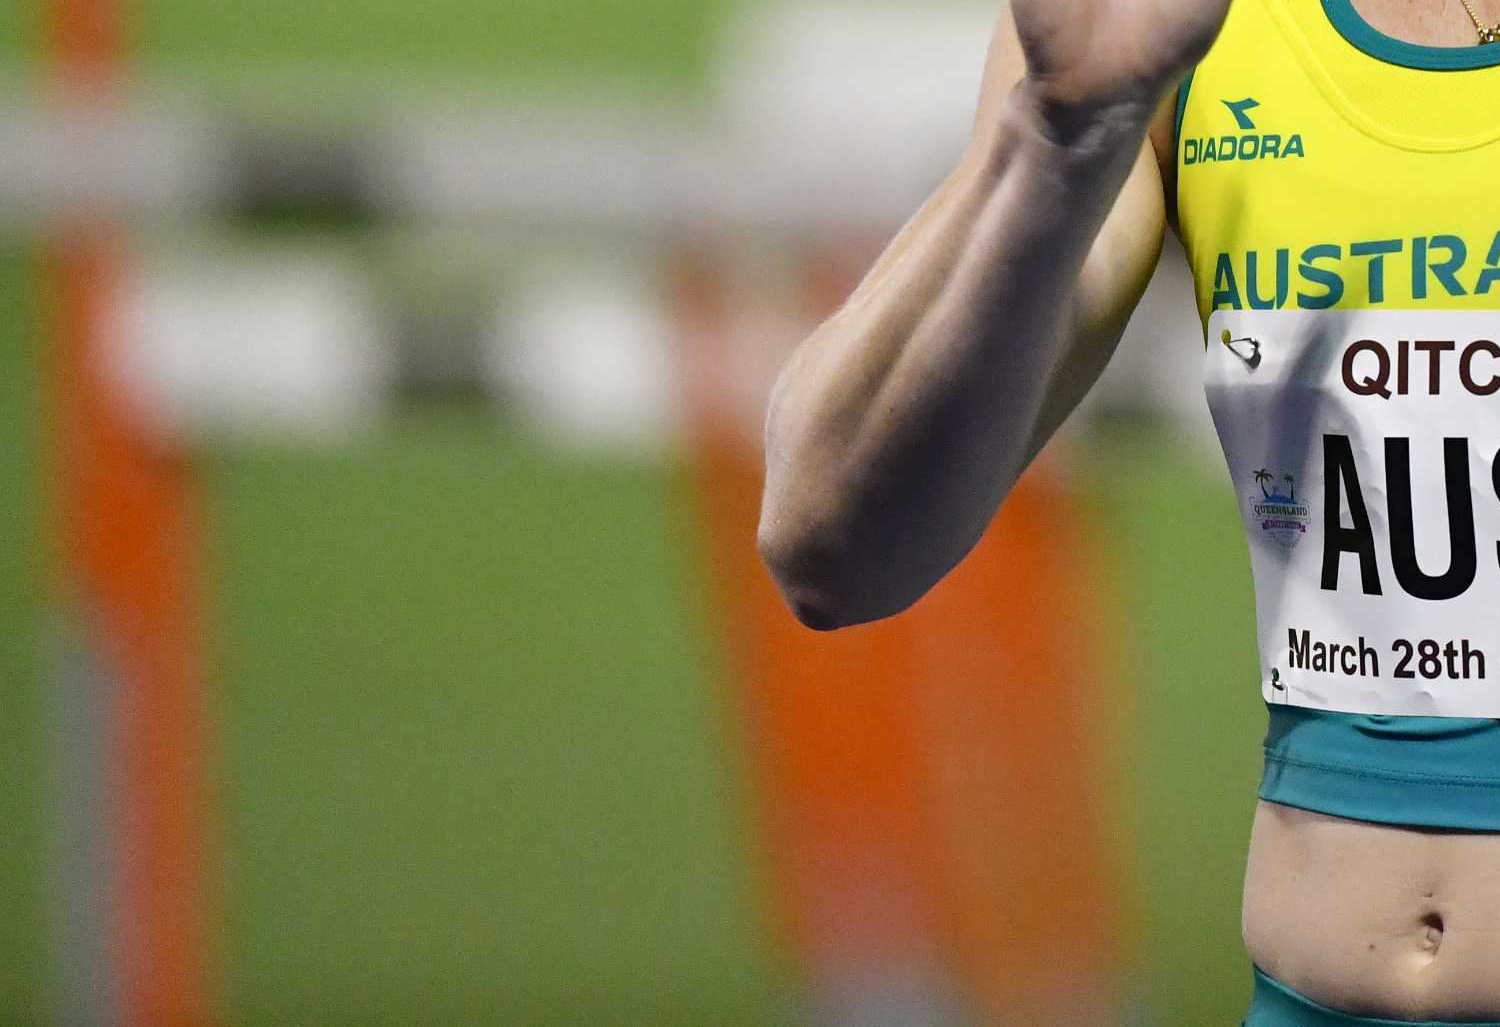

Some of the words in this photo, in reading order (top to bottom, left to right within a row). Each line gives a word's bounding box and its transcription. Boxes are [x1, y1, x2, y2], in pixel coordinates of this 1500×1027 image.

[1184, 134, 1305, 165] DIADORA
[1287, 628, 1379, 677] March
[1391, 639, 1485, 679] 28th
